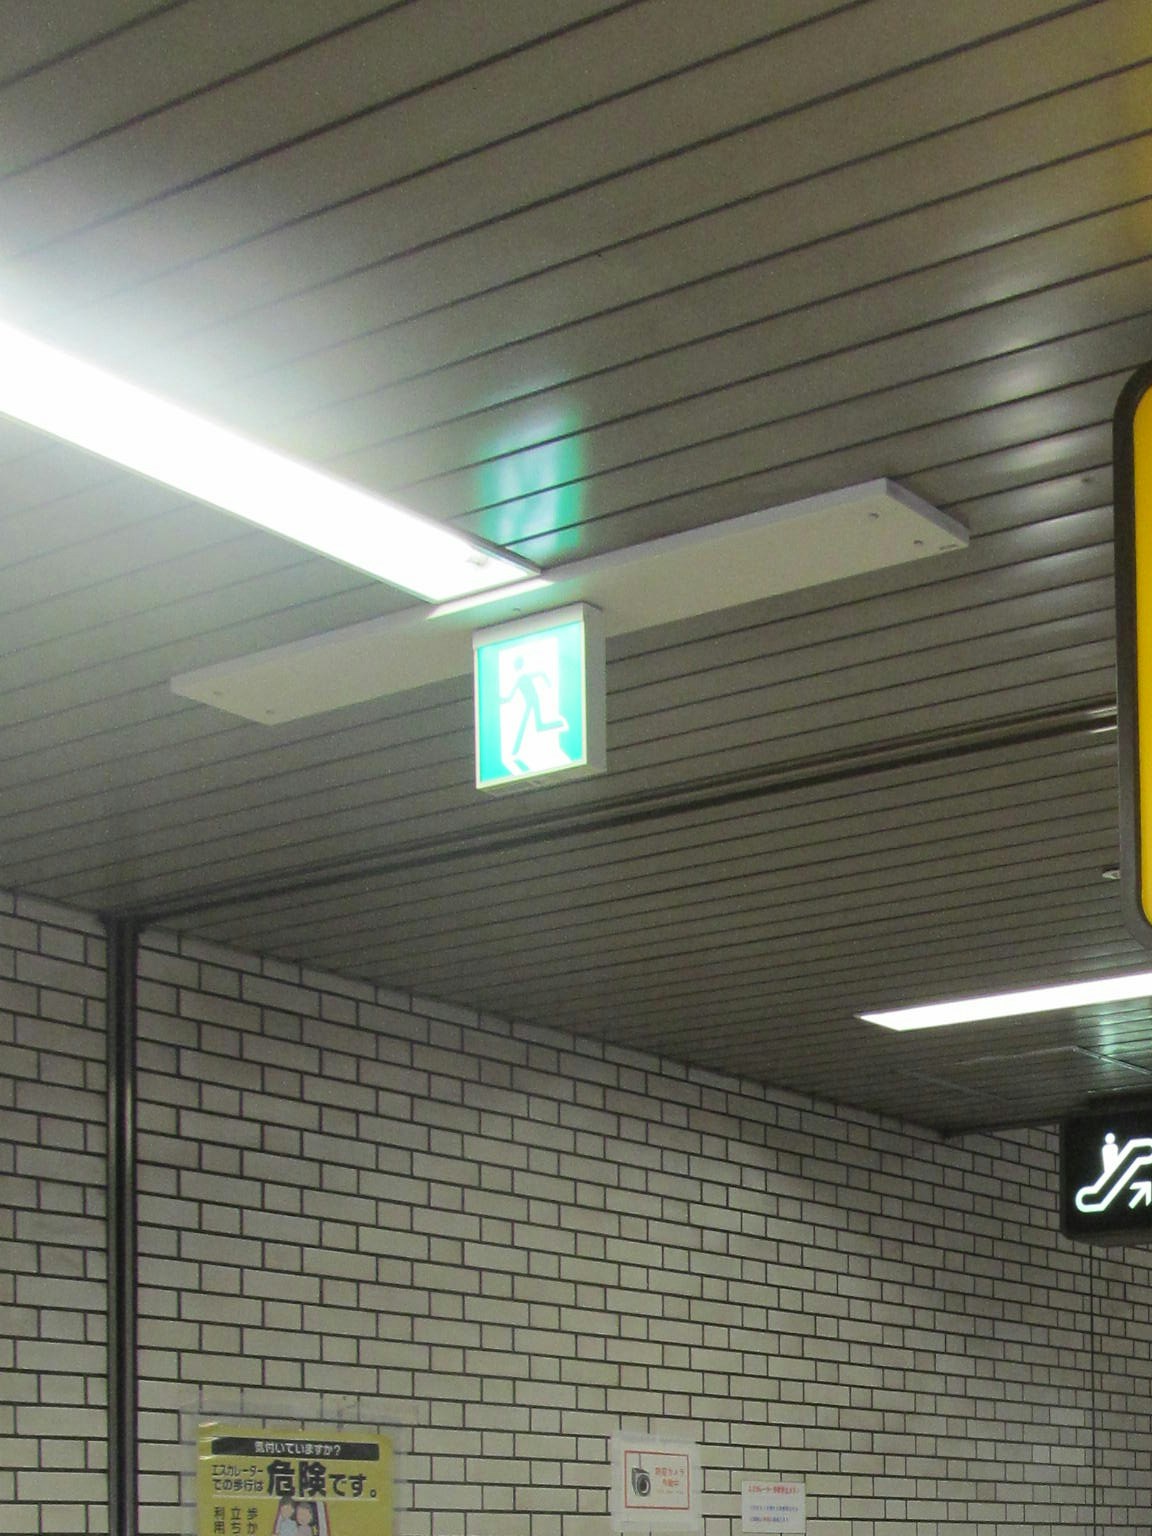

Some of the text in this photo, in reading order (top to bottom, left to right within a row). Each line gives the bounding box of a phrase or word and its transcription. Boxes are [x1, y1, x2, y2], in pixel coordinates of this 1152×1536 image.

[212, 1464, 264, 1477] エスカレーター
[267, 1459, 377, 1498] 危険です。
